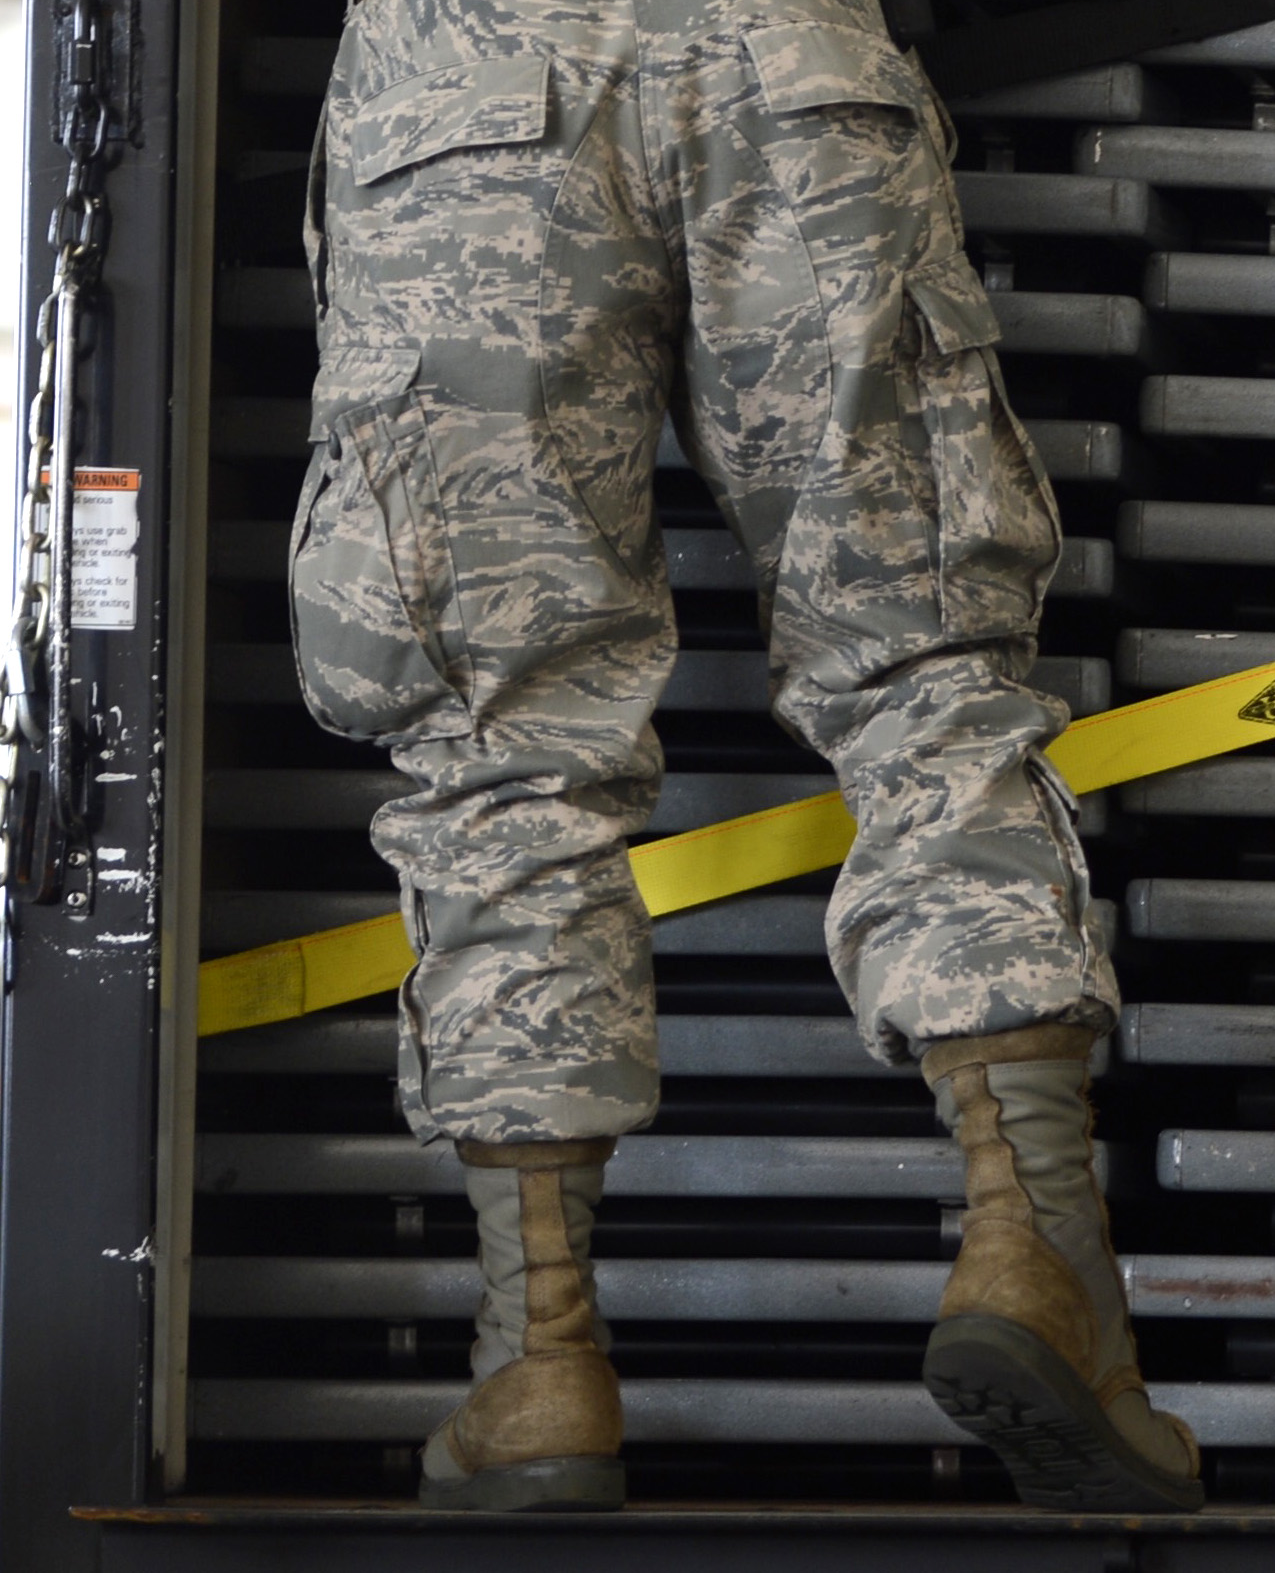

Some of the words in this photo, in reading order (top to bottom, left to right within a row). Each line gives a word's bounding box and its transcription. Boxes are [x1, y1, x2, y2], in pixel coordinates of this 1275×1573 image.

[74, 474, 129, 487] WARNING
[83, 496, 113, 504] serious
[106, 527, 128, 537] grab
[82, 538, 108, 546] when
[101, 548, 132, 559] exiting
[85, 576, 112, 586] check
[115, 576, 128, 586] for
[78, 587, 108, 596] before
[100, 599, 130, 609] exiting
